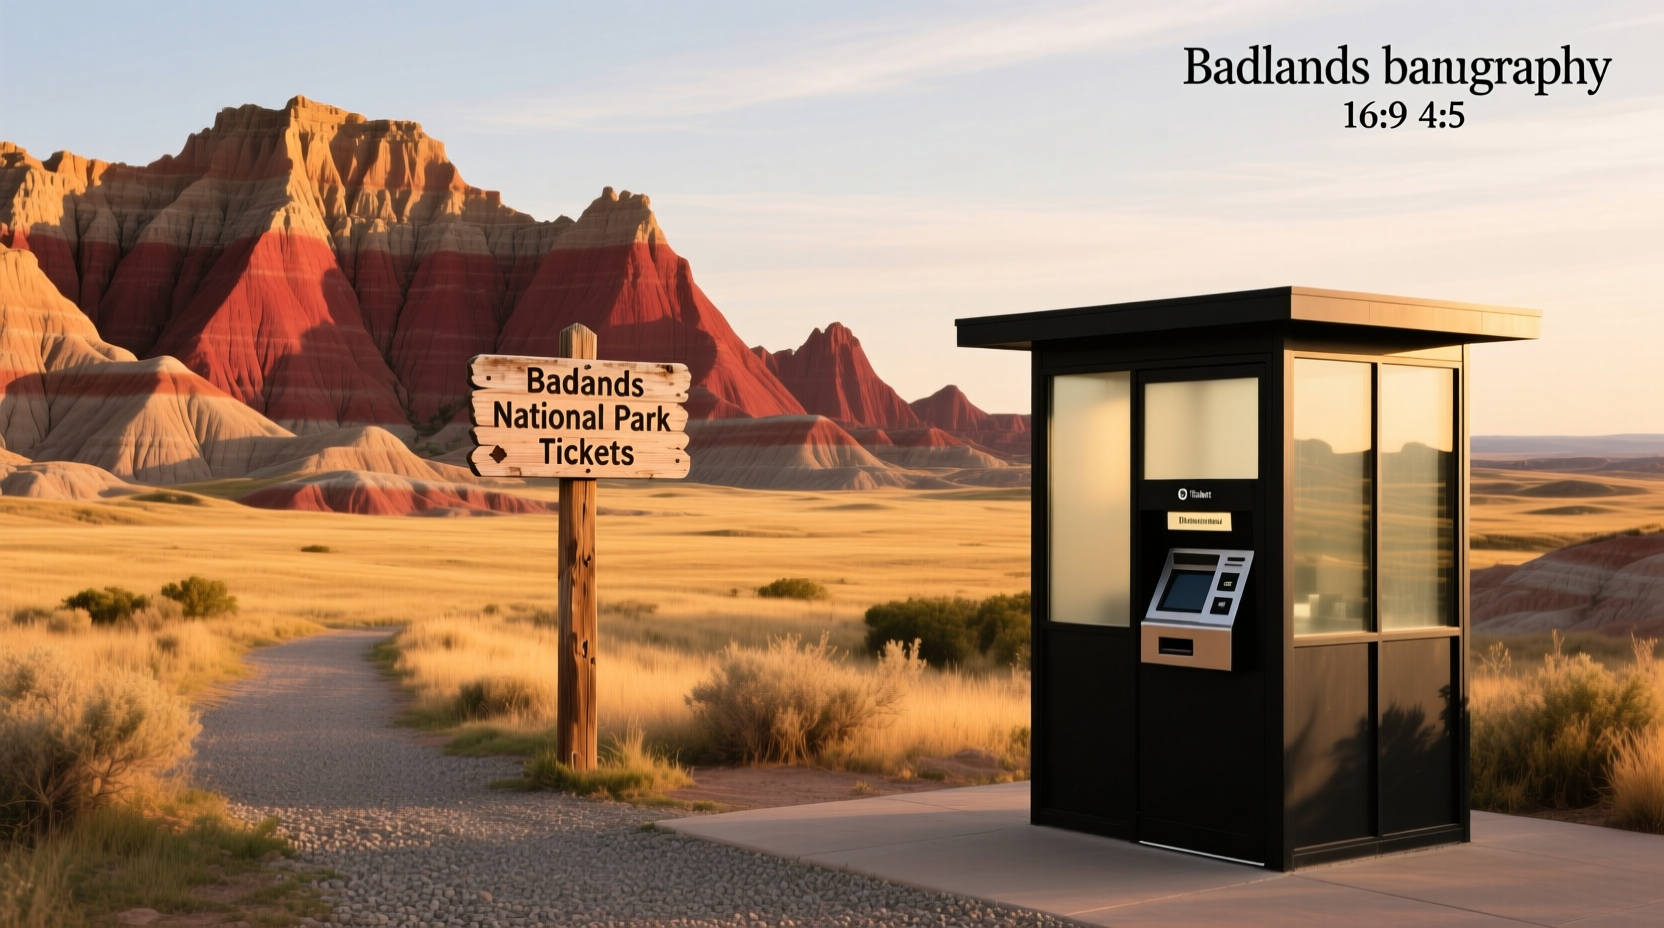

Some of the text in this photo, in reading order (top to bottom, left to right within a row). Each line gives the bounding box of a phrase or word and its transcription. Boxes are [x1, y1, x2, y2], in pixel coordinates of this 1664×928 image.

[527, 366, 644, 398] Badands
[493, 400, 672, 432] National Park
[538, 437, 635, 466] Tickets
